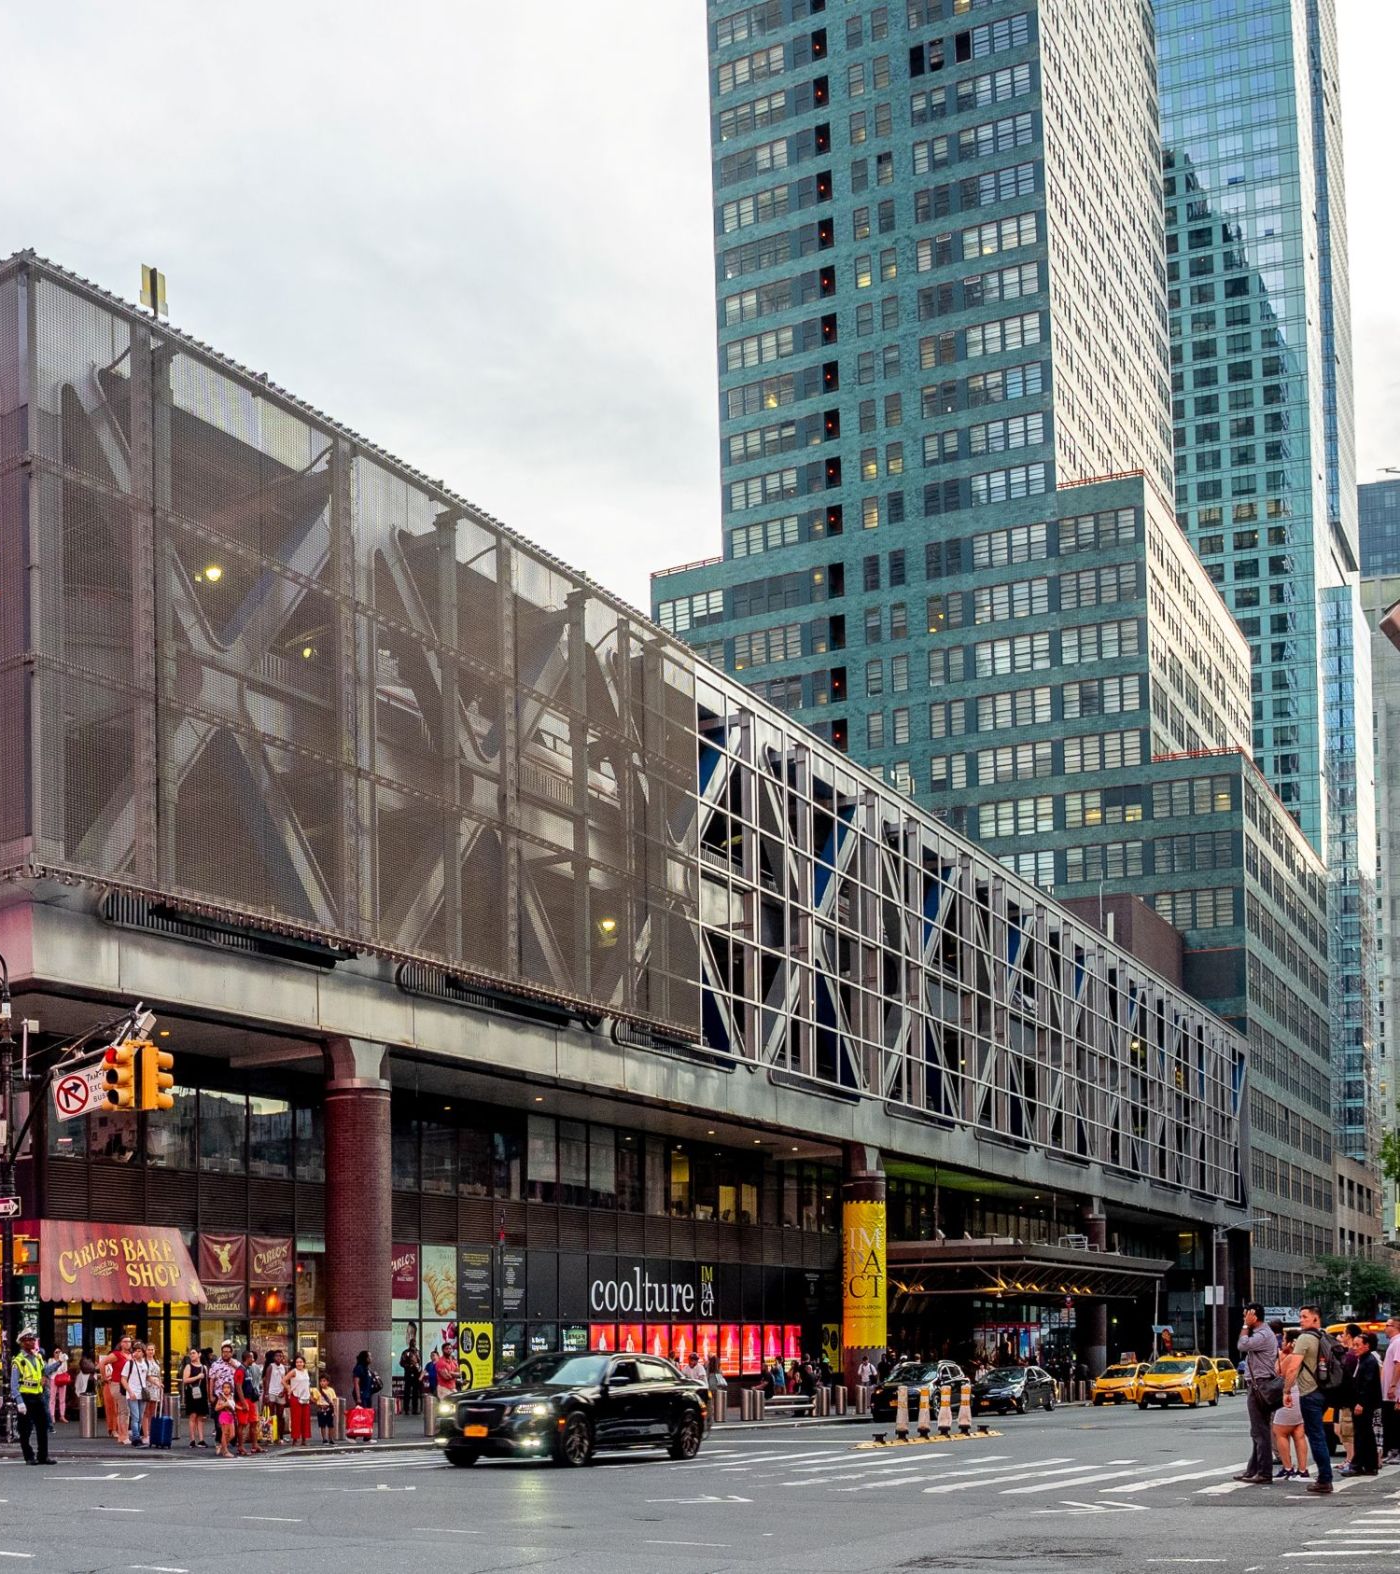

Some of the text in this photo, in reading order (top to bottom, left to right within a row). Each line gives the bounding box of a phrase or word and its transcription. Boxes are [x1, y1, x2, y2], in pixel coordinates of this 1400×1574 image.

[90, 1083, 102, 1092] EXC
[3, 1203, 15, 1211] WAY
[58, 1237, 175, 1284] CARLO'S BAKE
[253, 1246, 288, 1274] CARLO'S
[391, 1252, 415, 1272] ARLO'S
[125, 1263, 180, 1288] SHOP
[591, 1266, 695, 1313] coolture
